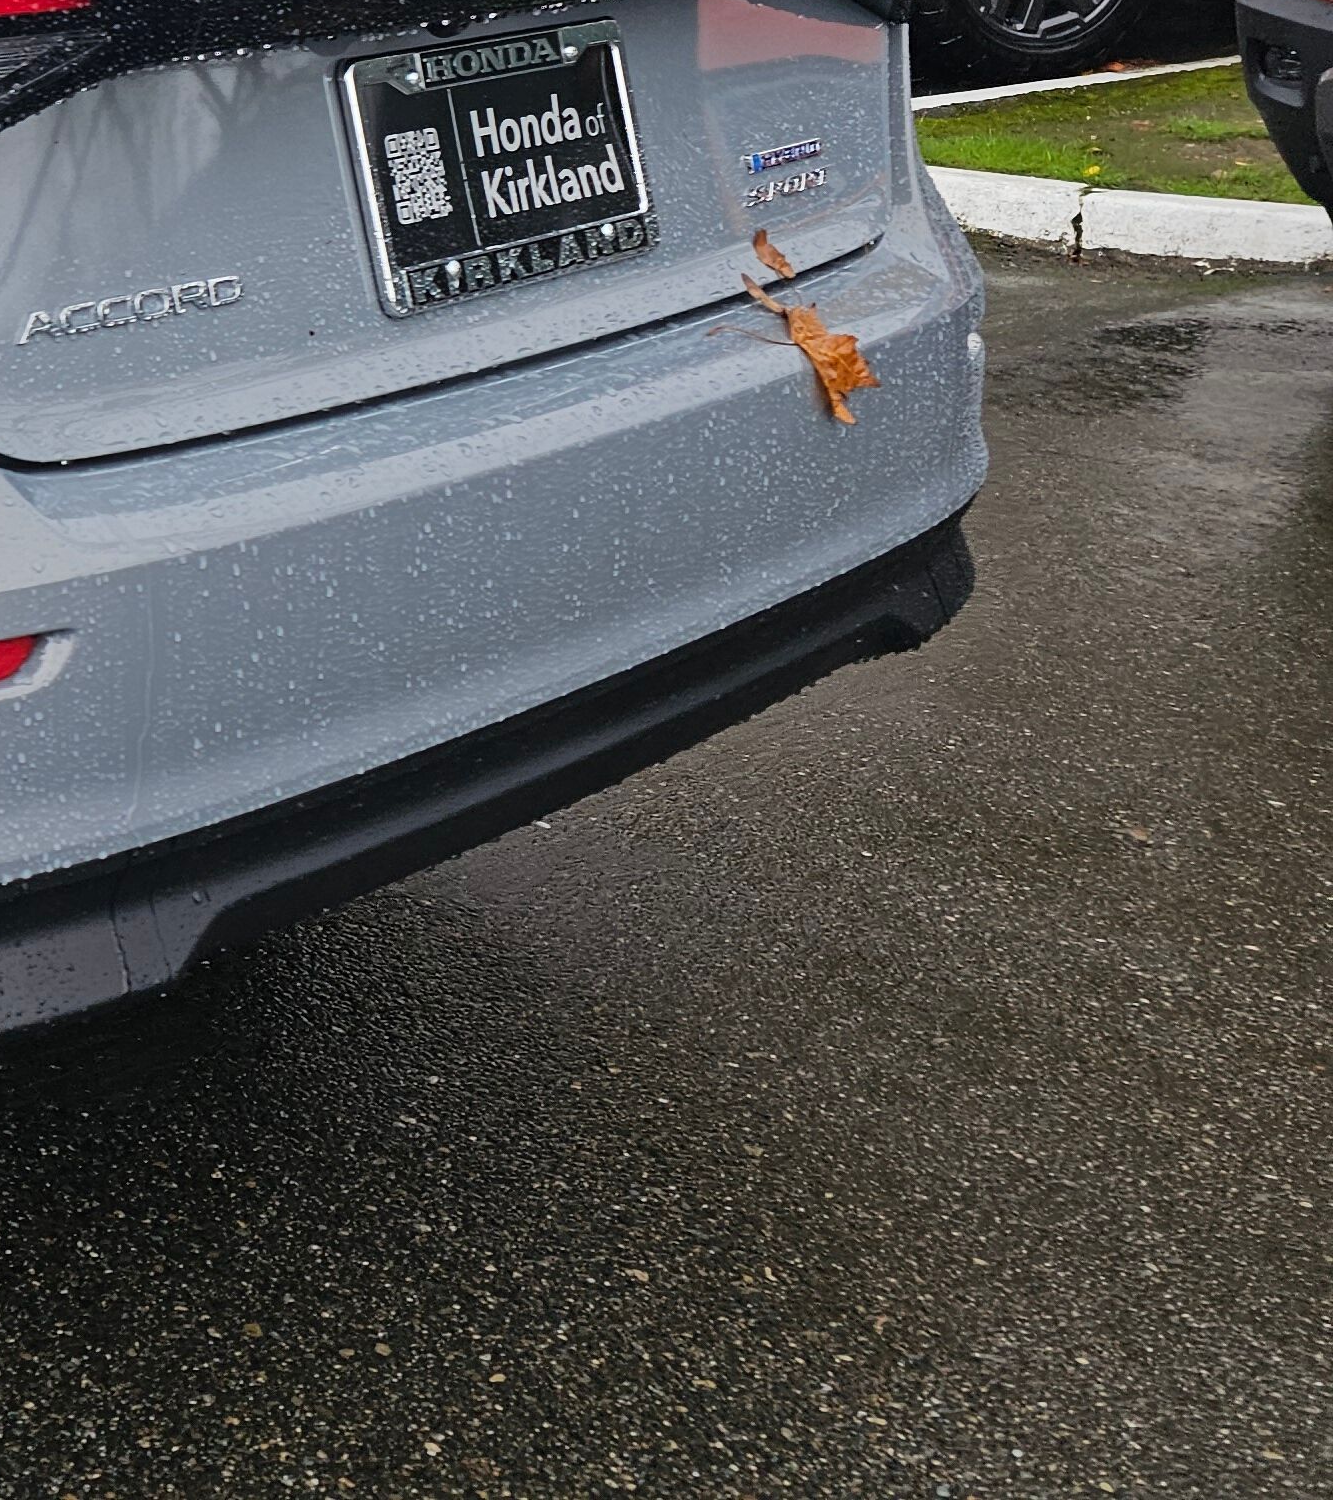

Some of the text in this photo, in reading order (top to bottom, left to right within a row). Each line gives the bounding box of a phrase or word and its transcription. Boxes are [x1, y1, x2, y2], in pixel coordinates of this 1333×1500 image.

[422, 37, 561, 83] HONDA
[469, 93, 606, 158] Honda of
[480, 143, 626, 219] Kirkland
[15, 275, 245, 345] ACCORD
